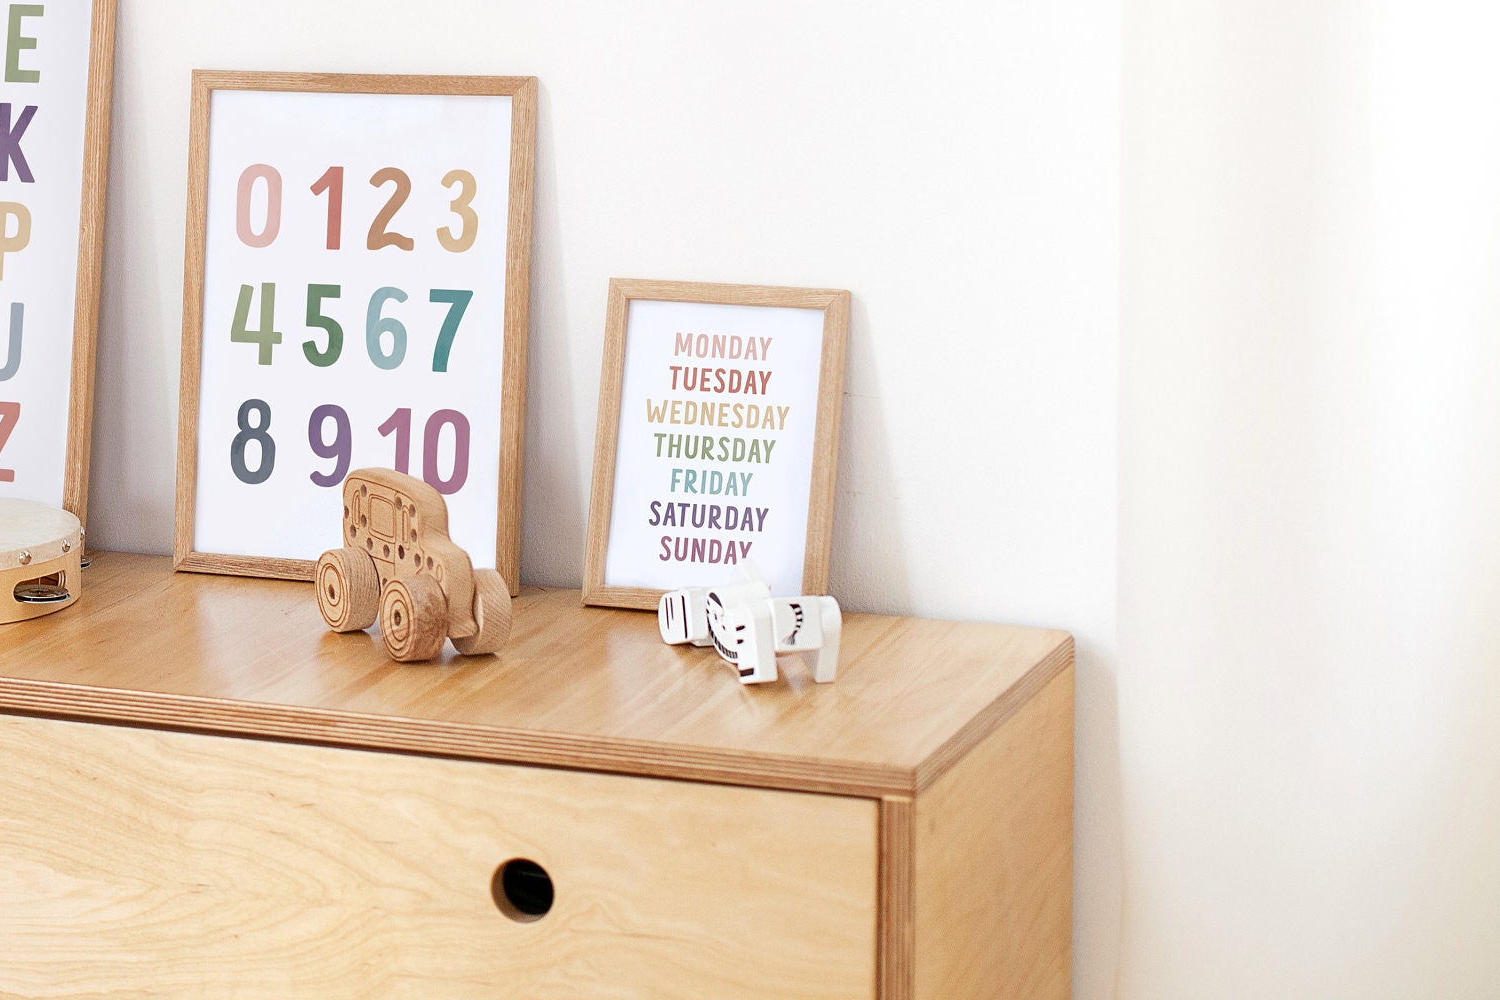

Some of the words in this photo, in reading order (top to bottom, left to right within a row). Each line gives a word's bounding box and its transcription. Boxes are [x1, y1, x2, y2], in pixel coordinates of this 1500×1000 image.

[674, 332, 772, 361] MONDAY
[669, 365, 772, 395] TUESDAY
[646, 398, 790, 430] WEDNESDAY
[654, 432, 776, 464] THURSDAY
[670, 468, 753, 497] FRIDAY
[648, 500, 769, 532] SATURDAY
[659, 535, 753, 565] SUNDAY
